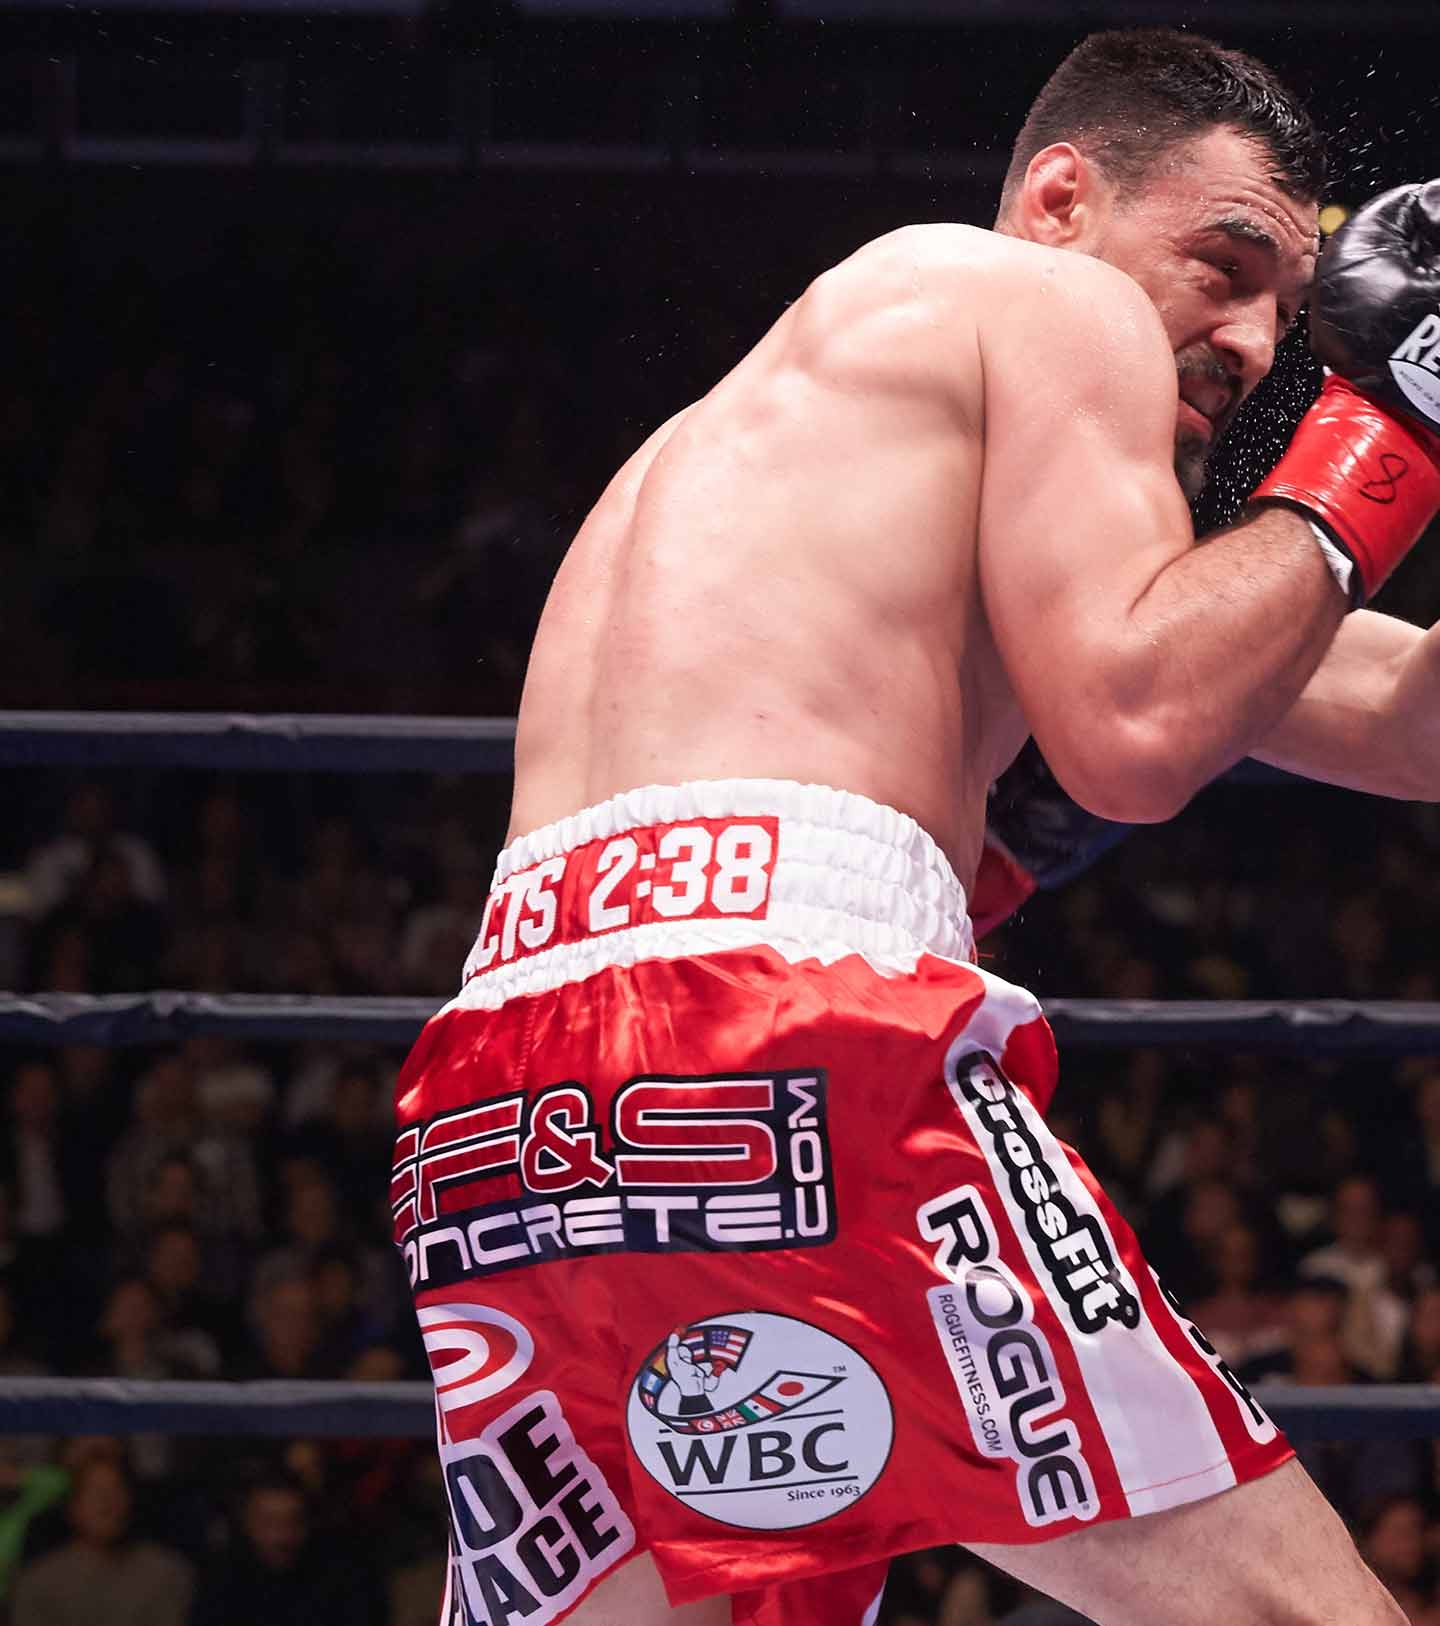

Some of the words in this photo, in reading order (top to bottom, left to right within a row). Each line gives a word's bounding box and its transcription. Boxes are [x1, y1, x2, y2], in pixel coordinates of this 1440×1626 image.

[588, 824, 772, 933] 2:38
[927, 1196, 1088, 1517] ROGUE
[937, 1293, 1002, 1453] ROGUEFITNESS.COM
[656, 1422, 849, 1487] WBC
[787, 1488, 825, 1502] Since
[830, 1484, 861, 1498] 1963
